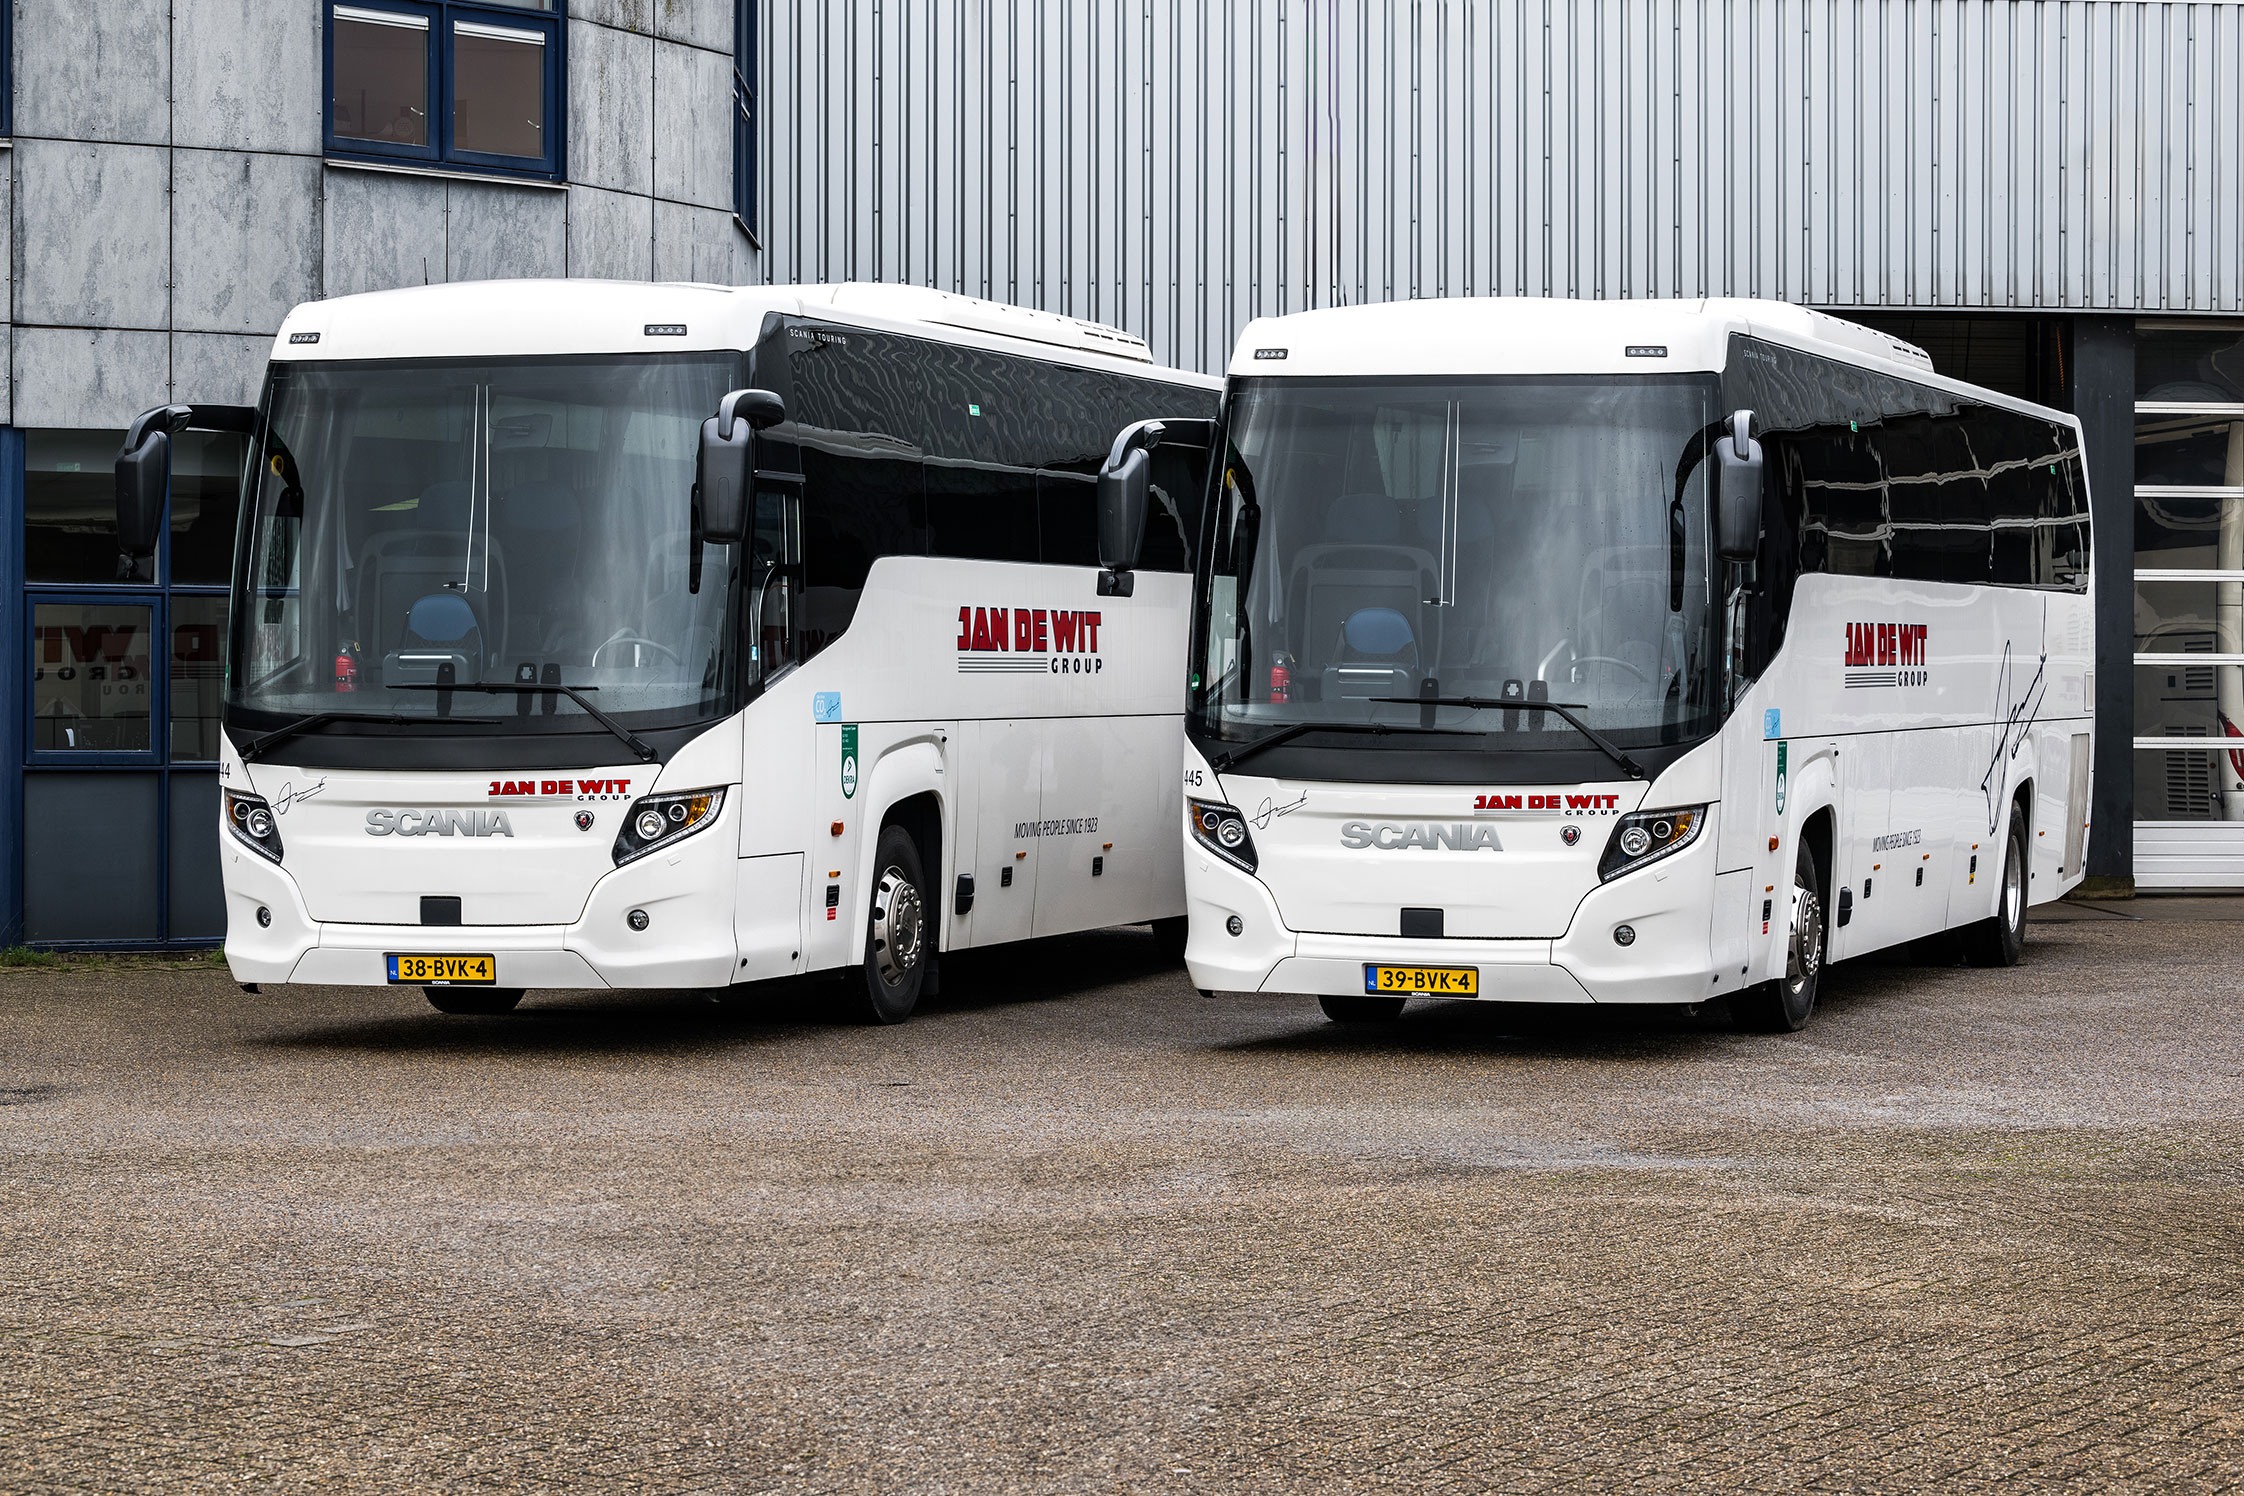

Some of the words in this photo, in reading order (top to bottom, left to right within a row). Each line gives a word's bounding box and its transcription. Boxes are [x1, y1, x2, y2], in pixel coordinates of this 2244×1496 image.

[790, 329, 814, 340] SCANIA
[818, 333, 846, 344] TOURING
[957, 606, 1009, 652] JAN
[1014, 608, 1048, 653] DE
[1050, 609, 1102, 654] WIT
[1845, 622, 1875, 667] JAN
[1878, 623, 1897, 667] DE
[1898, 623, 1928, 666] WIT
[1051, 657, 1102, 674] GROUP
[1898, 670, 1928, 687] GROUP
[488, 781, 535, 796] JAN
[541, 780, 574, 795] DE
[577, 779, 631, 794] WIT
[1474, 795, 1522, 809] JAN
[1528, 795, 1561, 809] DE
[1565, 795, 1619, 809] WIT
[365, 809, 514, 837] SCANIA
[1014, 821, 1042, 839] MOVING
[1042, 819, 1066, 837] PEOPLE
[1065, 818, 1084, 834] SINCE
[1084, 817, 1099, 833] 1923
[1340, 821, 1504, 851] SCANIA
[403, 959, 488, 977] 38-BVK-4
[1383, 970, 1470, 990] 39-BVK-4
